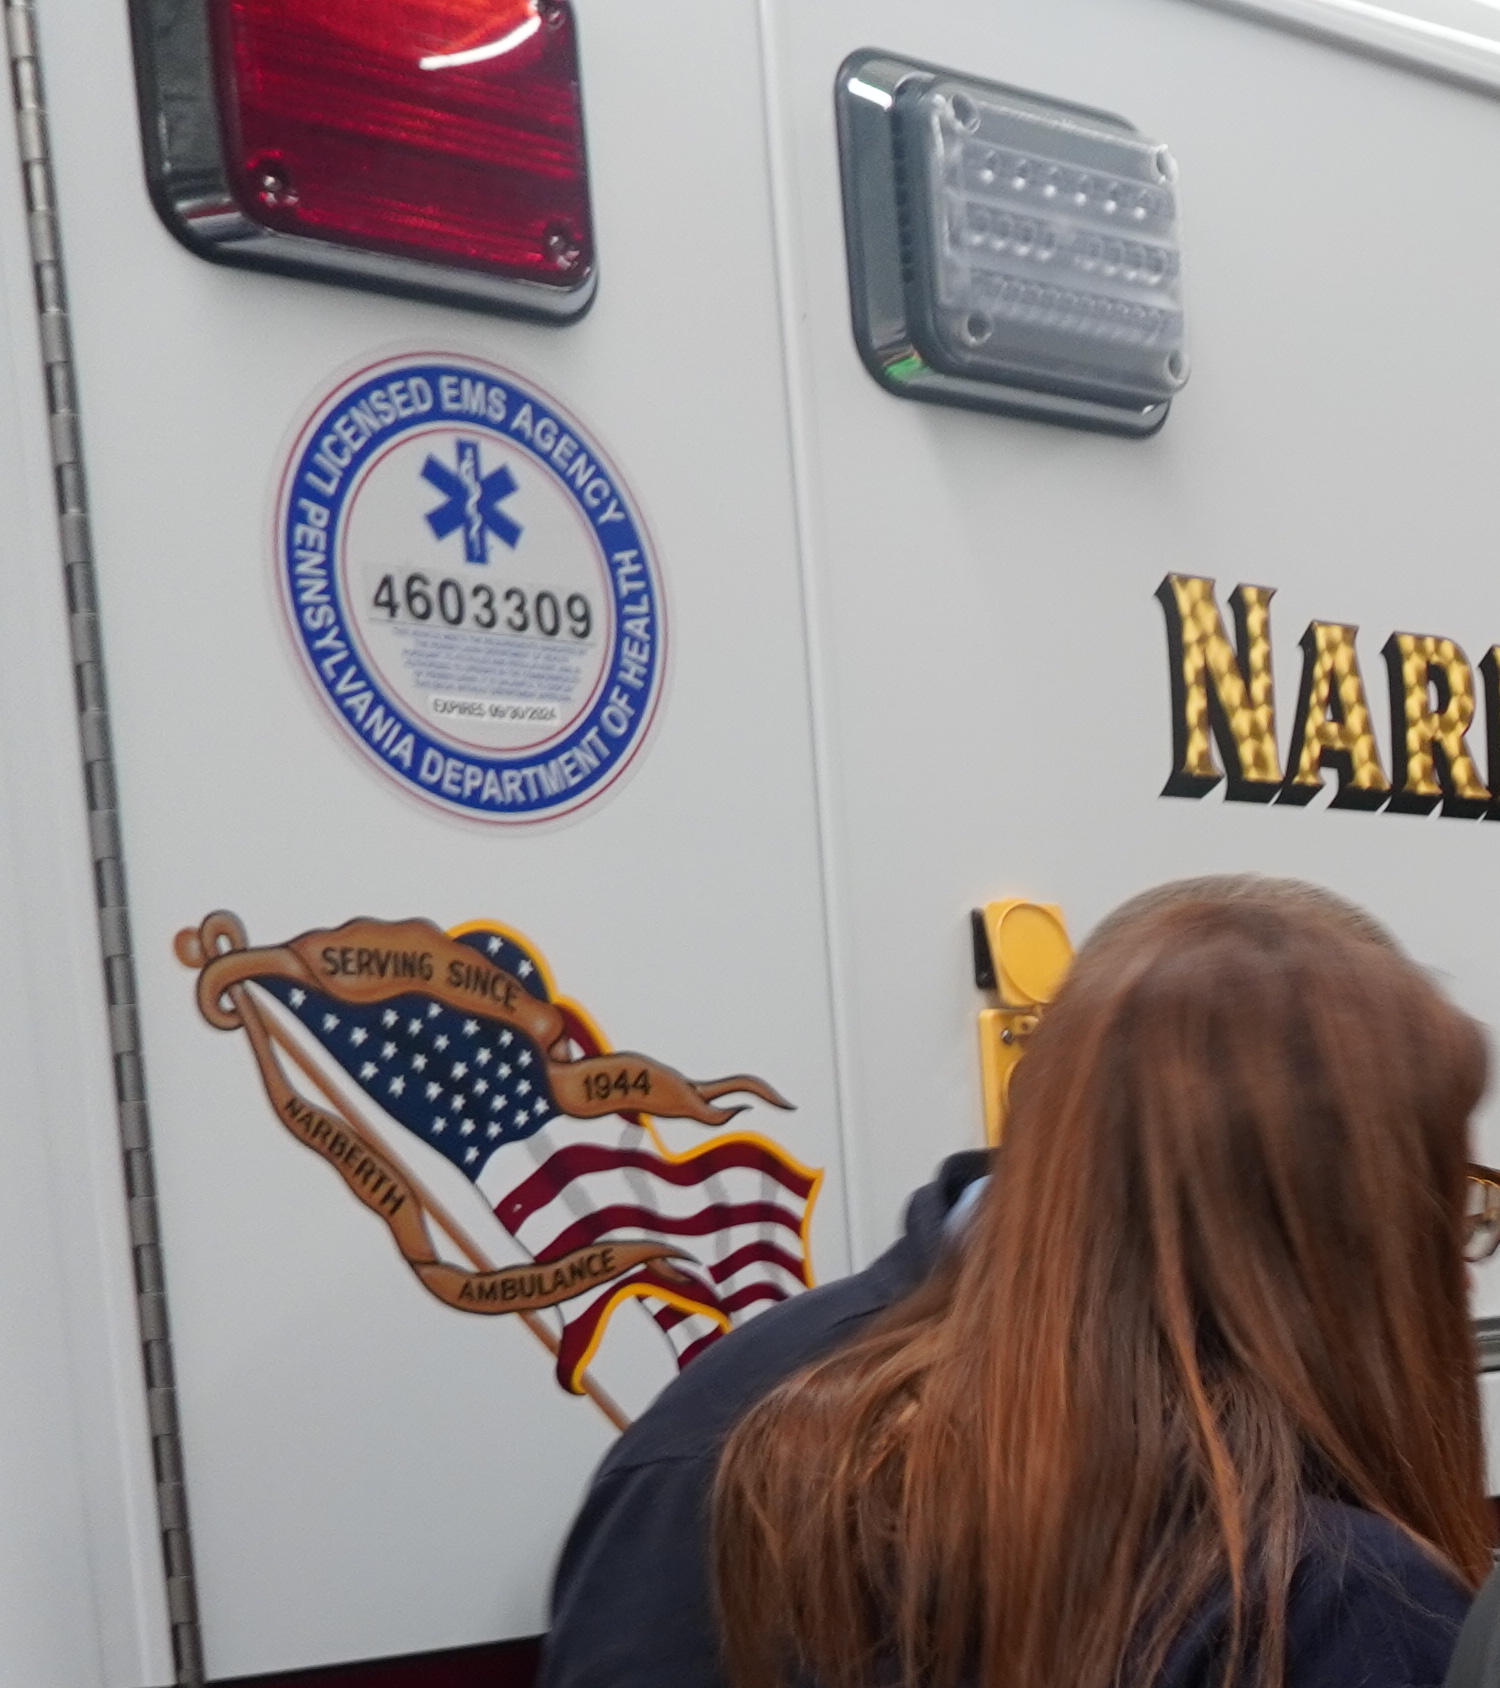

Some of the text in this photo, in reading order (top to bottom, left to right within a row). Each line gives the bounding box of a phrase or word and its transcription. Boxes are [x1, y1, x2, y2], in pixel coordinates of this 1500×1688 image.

[306, 375, 625, 524] LICENSED EMS AGENCY
[293, 497, 418, 773] PENNSYLVANIA
[372, 572, 594, 640] 4603309
[612, 550, 651, 692] HEALTH
[601, 695, 639, 739] OF
[418, 727, 612, 804] DEPARTMENT
[322, 946, 523, 1014] SERVING SINCE
[583, 1068, 652, 1100] 1944
[284, 1097, 406, 1217] NARBERTH
[458, 1247, 618, 1302] AMBULANCE
